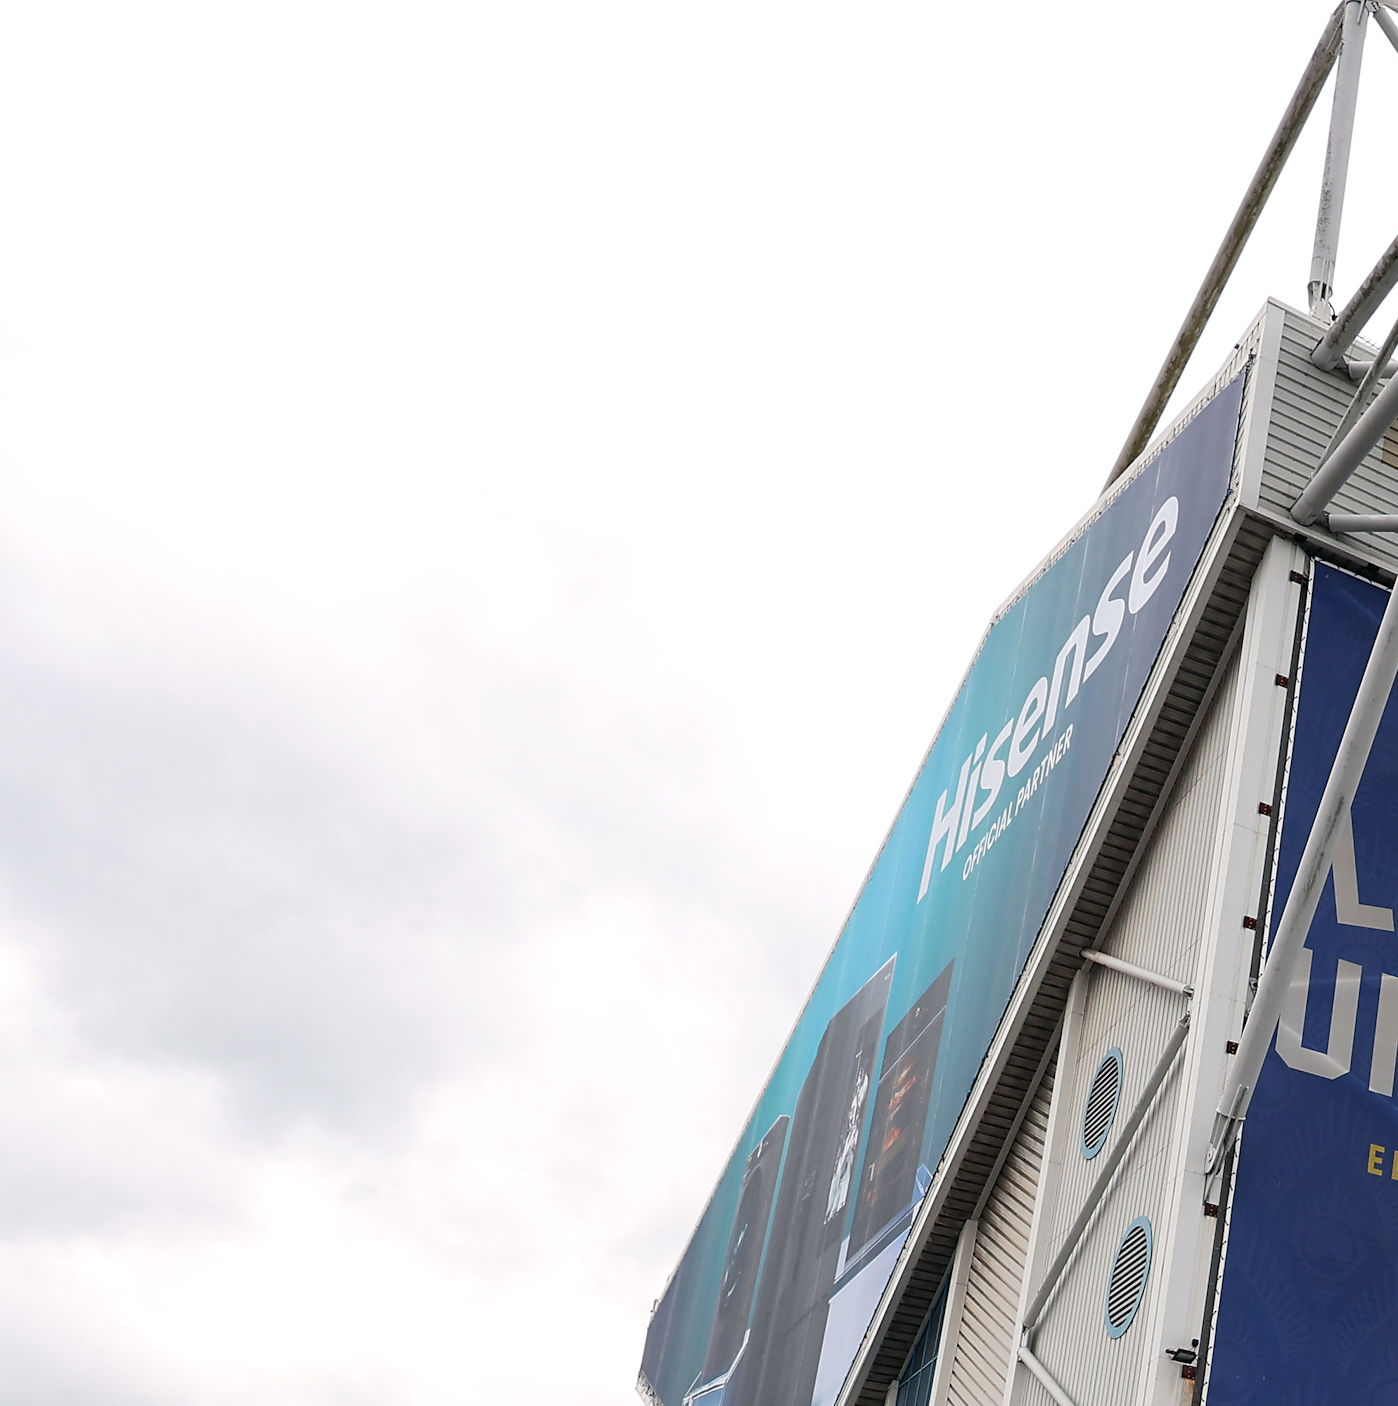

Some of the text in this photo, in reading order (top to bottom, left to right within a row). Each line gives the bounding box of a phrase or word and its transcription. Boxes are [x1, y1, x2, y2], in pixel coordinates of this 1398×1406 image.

[917, 496, 1179, 904] Hisense
[962, 723, 1074, 881] OFFICIAL PARTNER
